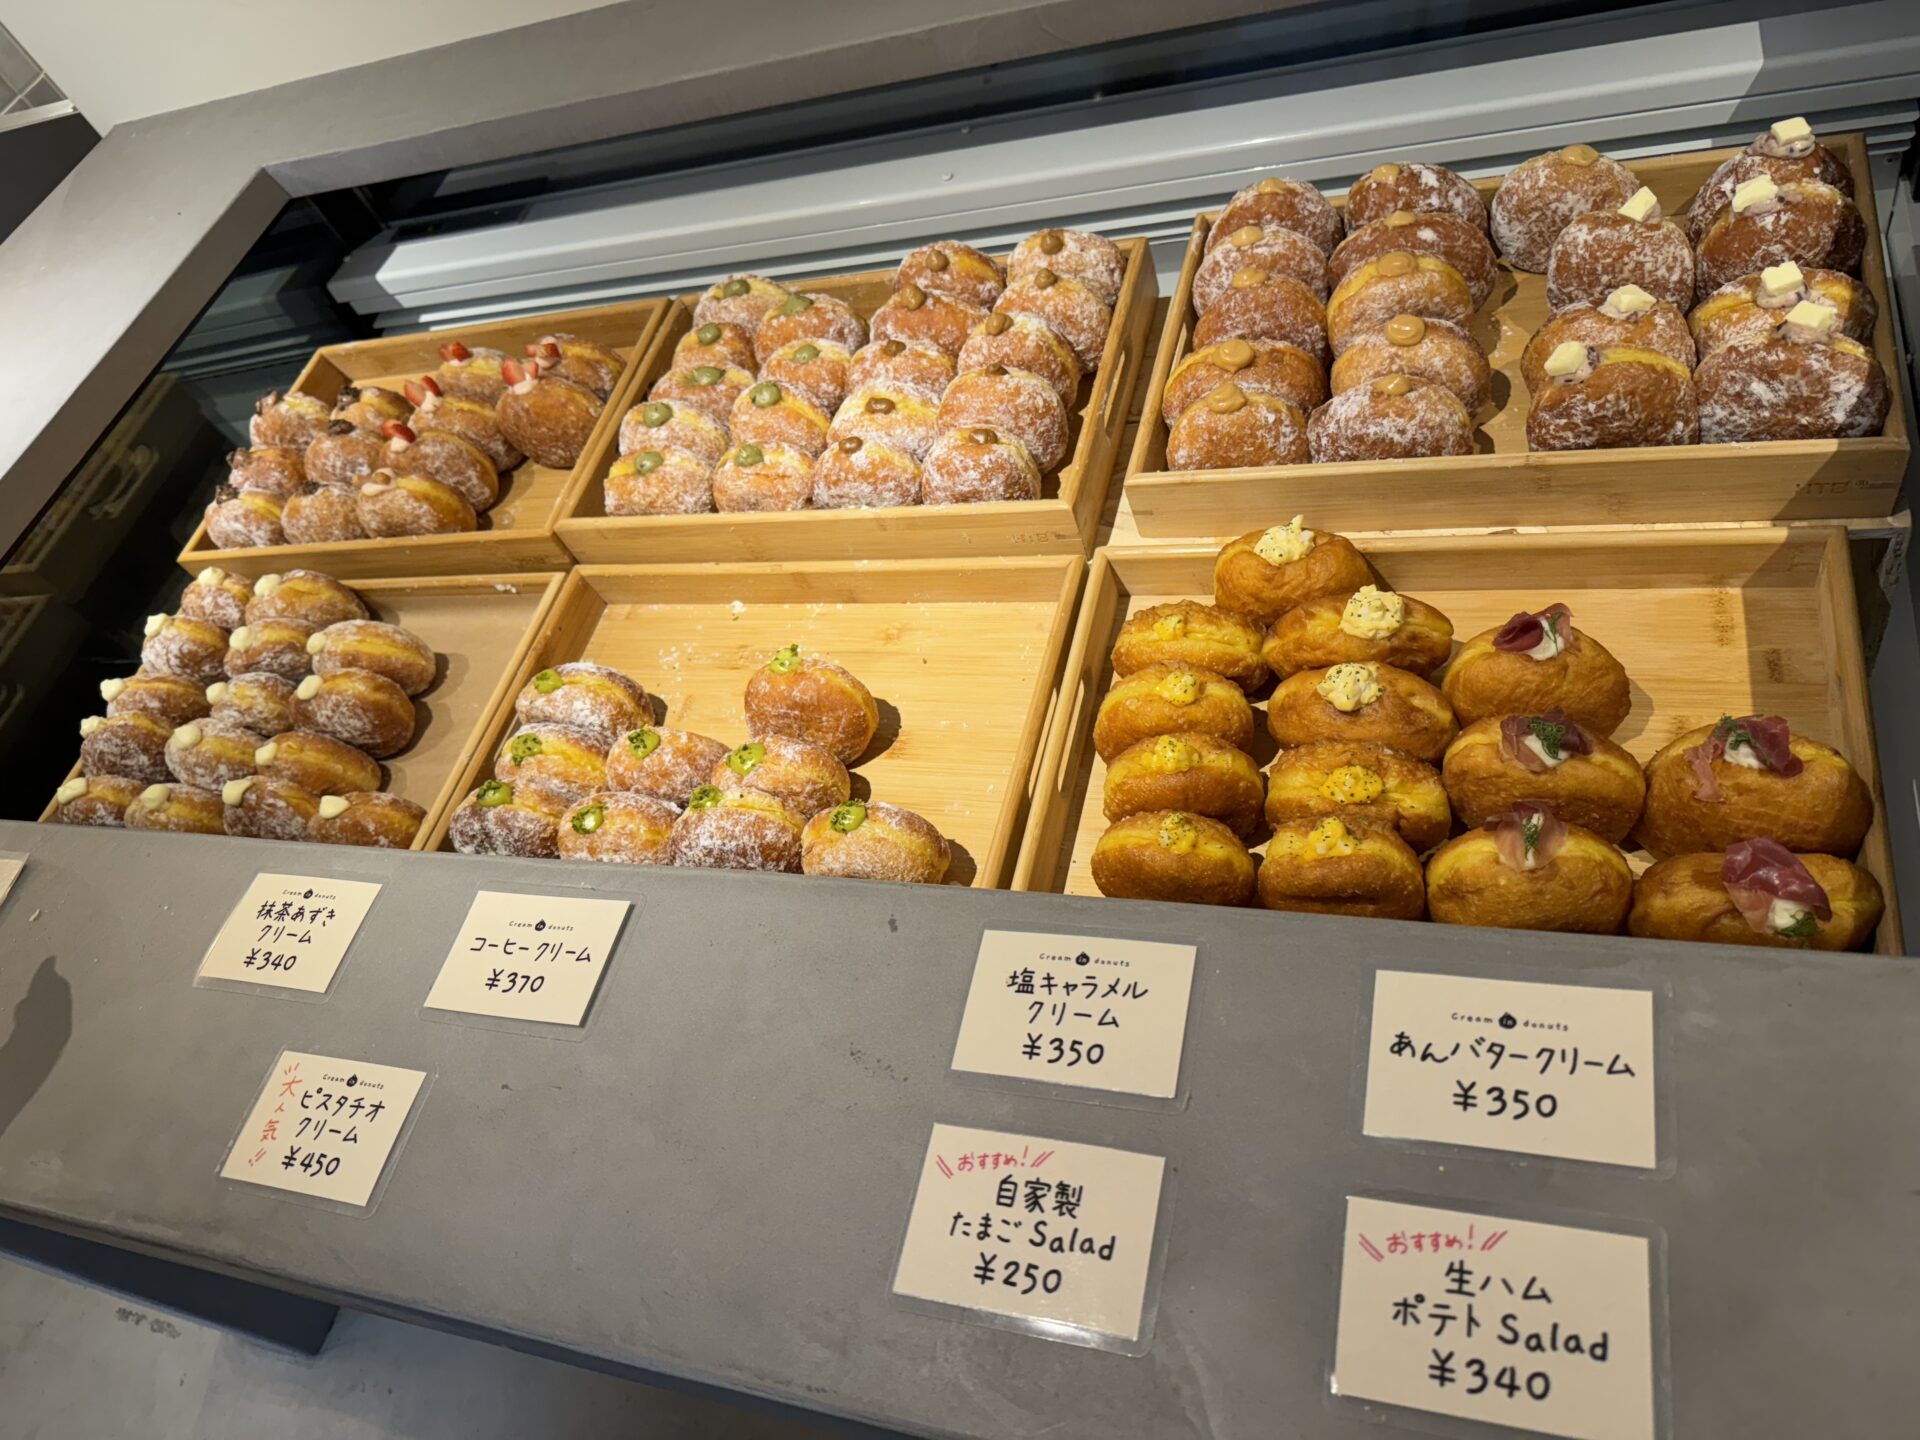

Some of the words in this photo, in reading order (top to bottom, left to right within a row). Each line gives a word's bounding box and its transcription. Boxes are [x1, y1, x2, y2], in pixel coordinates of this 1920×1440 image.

[256, 901, 336, 928] 抹茶あずき
[508, 920, 533, 929] Cream
[547, 923, 574, 931] donuts
[256, 924, 311, 944] クリーム
[243, 947, 296, 971] ¥340
[1039, 953, 1072, 962] Cream
[1094, 957, 1130, 967] donuts
[485, 969, 544, 993] ¥370
[1007, 967, 1148, 1000] 塩キャラメル
[1028, 1001, 1120, 1028] クリーム
[1452, 1012, 1493, 1023] Cream
[1523, 1020, 1569, 1031] donuts
[1022, 1033, 1104, 1066] ¥350
[1390, 1032, 1635, 1077] あんバタークリーム
[300, 1089, 385, 1122] ピスタチオ
[1452, 1080, 1558, 1119] ¥350
[295, 1117, 358, 1144] クリーム
[282, 1145, 340, 1175] ¥450
[996, 1175, 1084, 1219] 自家製
[974, 1253, 1062, 1294] ¥250
[1445, 1260, 1552, 1303] 生ハム
[1428, 1349, 1550, 1400] ¥340
